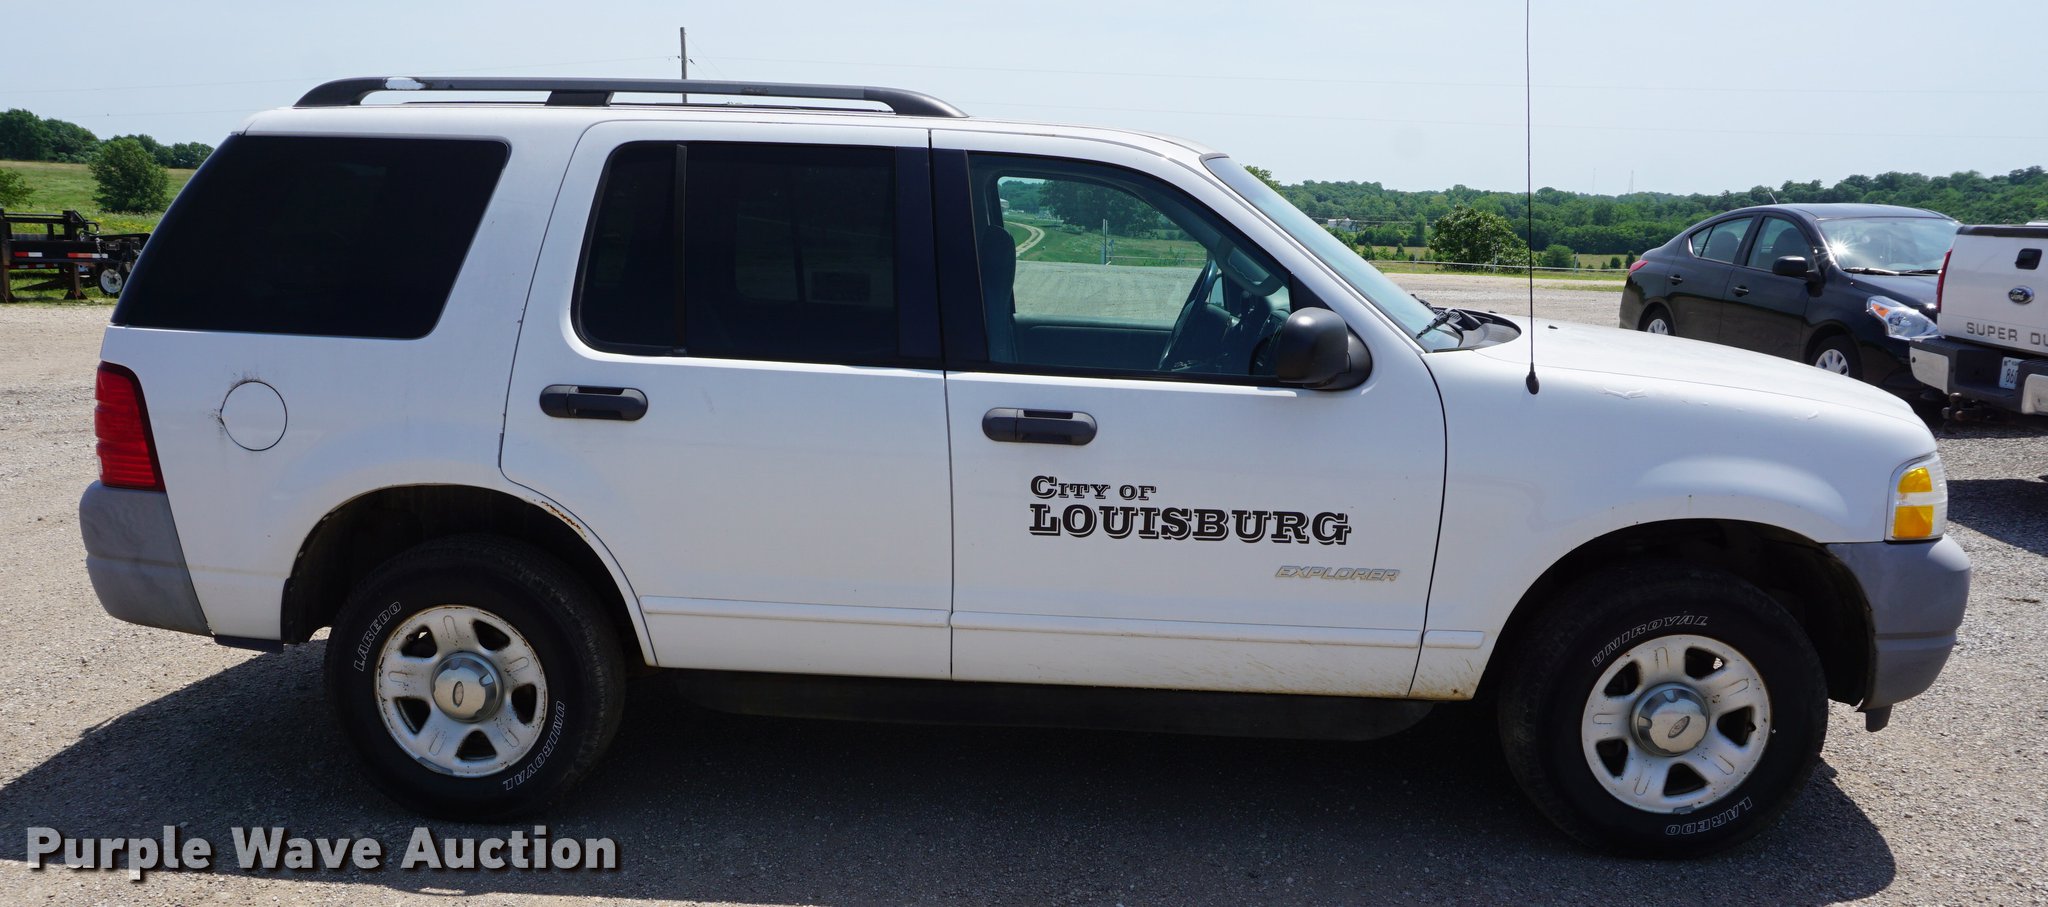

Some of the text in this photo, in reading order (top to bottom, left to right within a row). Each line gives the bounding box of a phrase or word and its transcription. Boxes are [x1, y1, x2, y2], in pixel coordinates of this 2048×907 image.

[1966, 321, 2018, 342] SUPER
[1028, 503, 1352, 546] LOUISBURG
[1275, 565, 1400, 581] EXPLORER
[353, 601, 402, 672] LAREDO
[1591, 614, 1709, 668] UNIROYAL
[503, 701, 566, 791] UNIROYAL
[1664, 796, 1753, 836] LAREDO
